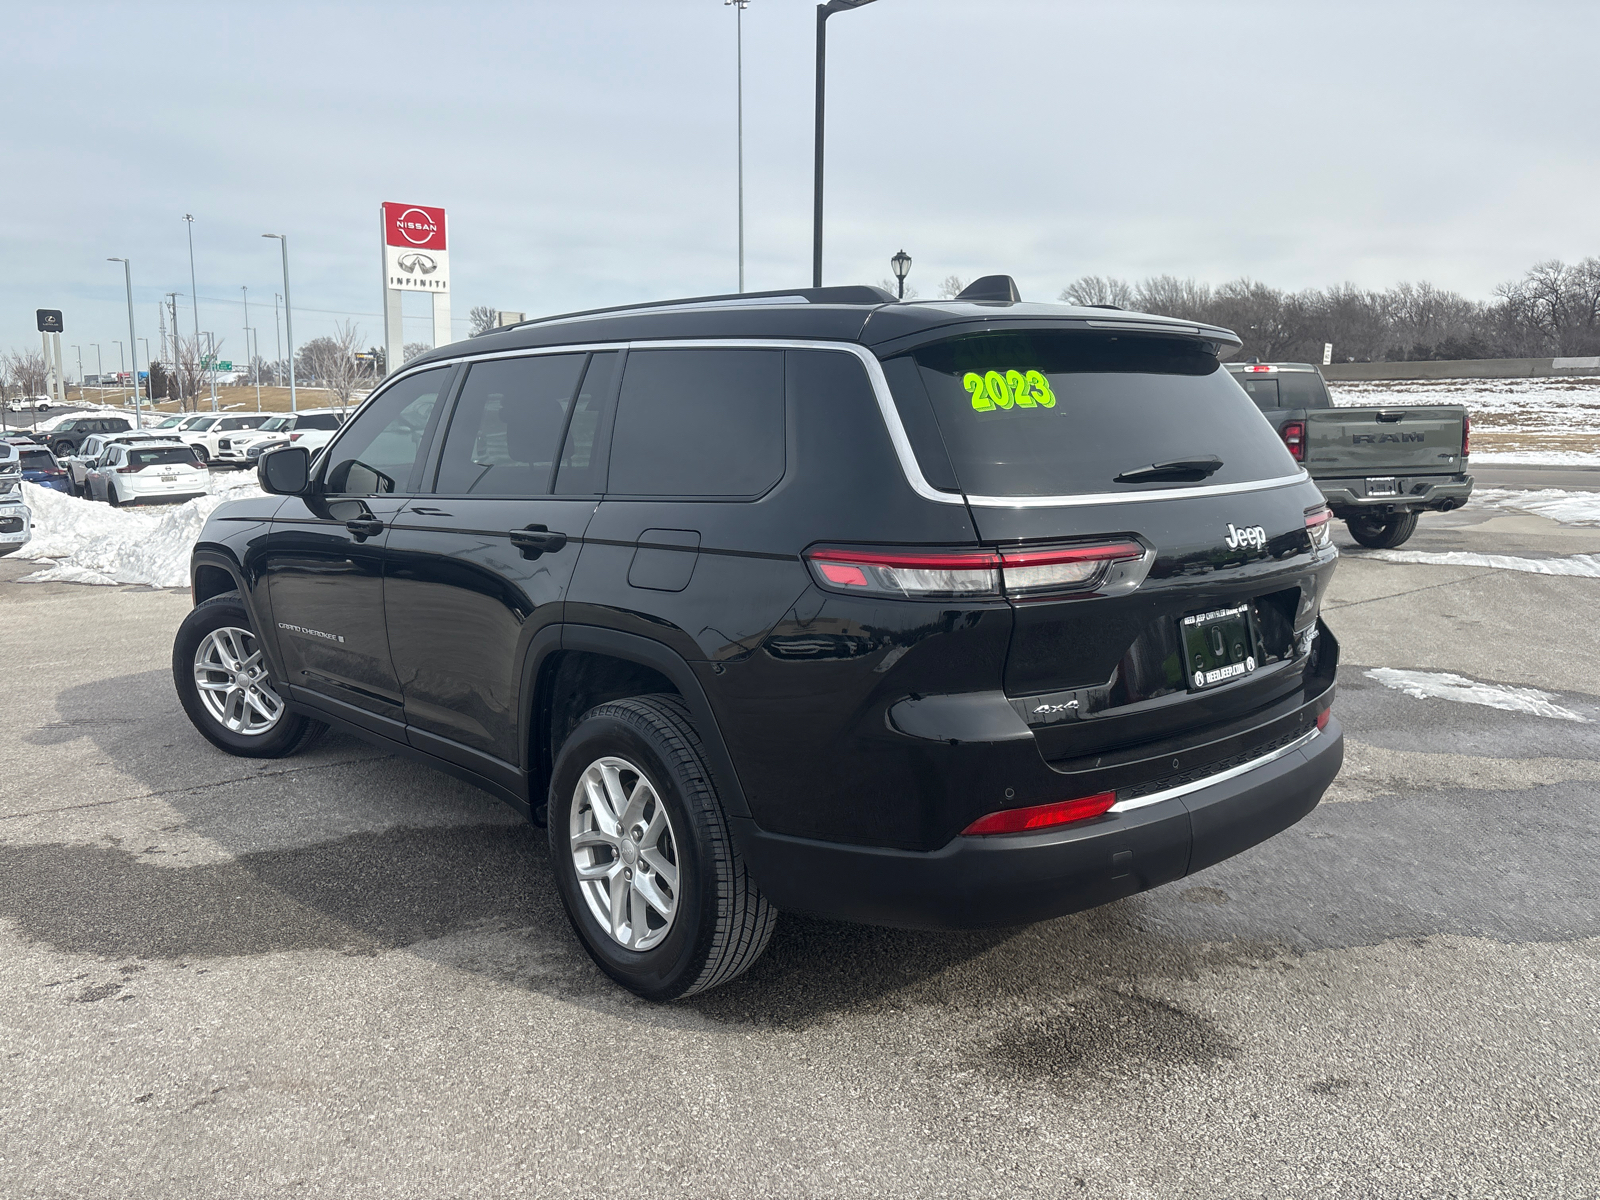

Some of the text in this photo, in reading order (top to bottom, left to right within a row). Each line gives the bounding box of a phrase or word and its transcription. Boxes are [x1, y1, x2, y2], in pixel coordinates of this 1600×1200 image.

[397, 220, 437, 231] NISSAN
[390, 277, 446, 289] INFINITI
[963, 370, 1056, 412] 2023
[1352, 432, 1425, 444] RAM
[1225, 523, 1266, 550] Jeep
[278, 622, 301, 632] GRAND
[301, 627, 338, 641] CHEROKEE
[1206, 662, 1246, 683] REEDJEEP.COM
[1033, 700, 1080, 714] 4x4
